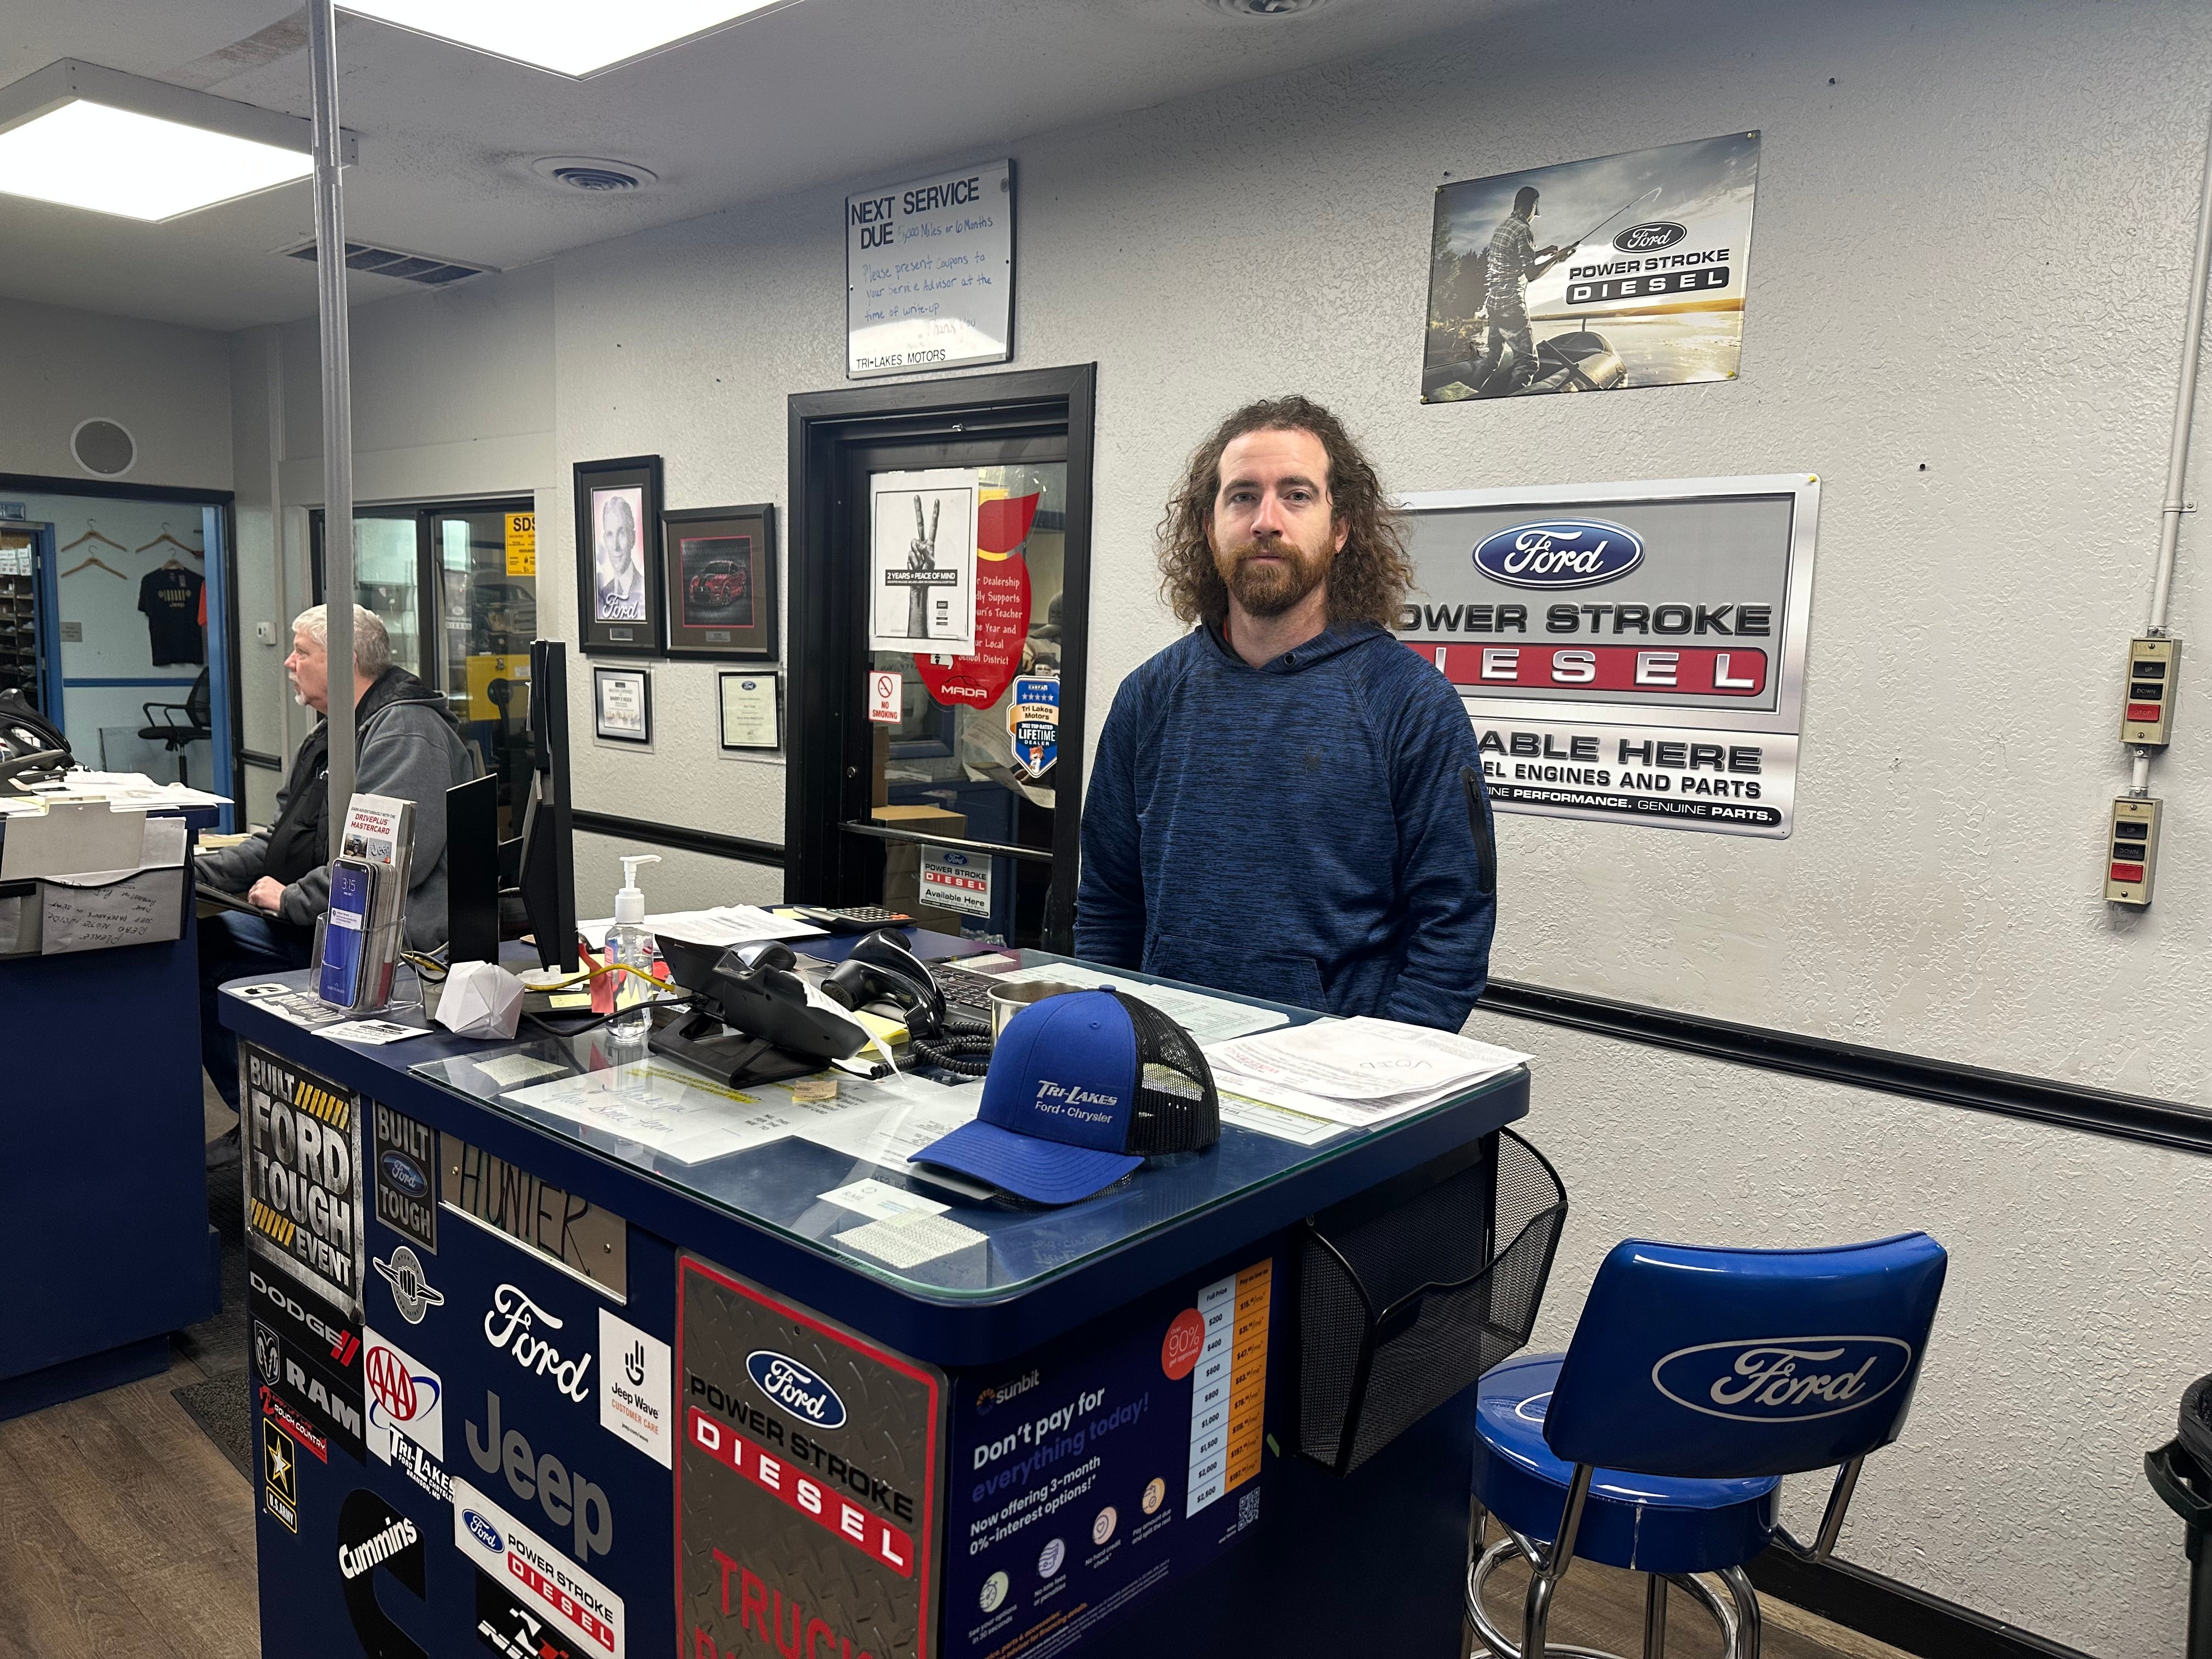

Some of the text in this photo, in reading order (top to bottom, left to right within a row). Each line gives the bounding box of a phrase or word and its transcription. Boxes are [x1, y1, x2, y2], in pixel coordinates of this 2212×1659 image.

[851, 177, 979, 225] NEXT SERVICE
[861, 222, 894, 249] DUE
[921, 223, 941, 238] Miles
[956, 221, 962, 233] 6
[964, 217, 993, 231] Months
[1627, 227, 1671, 249] Ford
[862, 263, 891, 283] Please
[896, 255, 932, 279] present
[975, 251, 985, 263] to
[1570, 249, 1729, 280] POWER STROKE
[923, 277, 956, 291] Advisor
[962, 277, 973, 285] at
[977, 273, 991, 285] the
[1573, 270, 1723, 301] DIESEL
[865, 303, 939, 322] time of write-up
[856, 349, 945, 369] TRI-LAKES MOTORS
[1504, 531, 1607, 574] Ford
[983, 577, 1020, 590] Dealership
[988, 591, 1020, 605] Supports
[603, 594, 638, 618] Ford
[995, 608, 1022, 619] Teacher
[1401, 602, 1772, 636] OWER STROKE
[985, 623, 1016, 634] Year and
[985, 639, 1003, 648] Local
[983, 654, 1008, 665] District
[1435, 647, 1754, 688] IESEL
[881, 701, 889, 709] NO
[941, 685, 987, 698] MADA
[873, 710, 898, 719] SMOKING
[1019, 729, 1055, 741] LIFETIME
[1618, 739, 1762, 774] HERE
[1515, 765, 1610, 786] ENGINES
[1620, 772, 1669, 790] AND
[1681, 777, 1760, 797] PARTS
[356, 814, 387, 825] DRIVEPLUS
[1514, 789, 1631, 808] PERFORMANCE.
[1638, 800, 1706, 815] GENUINE
[1712, 807, 1772, 821] PARTS.
[351, 821, 390, 834] MASTERCARD
[926, 864, 986, 880] POWER STROKE
[947, 854, 963, 864] Ford
[342, 878, 356, 891] 3:15
[926, 872, 984, 890] DIESEL
[926, 889, 984, 906] Available Here
[250, 1054, 295, 1104] BUILT
[1036, 1080, 1118, 1106] TRI-LAKES
[1035, 1101, 1113, 1124] Ford Chrysler
[252, 1089, 349, 1195] FORD
[378, 1107, 428, 1162] BUILT
[391, 1160, 416, 1188] Ford
[254, 1149, 350, 1255] TOUGH
[380, 1184, 431, 1239] TOUGH
[460, 1142, 590, 1277] HUNTER
[296, 1231, 351, 1287] EVENT
[250, 1271, 343, 1351] DODGE
[1209, 1313, 1222, 1326] $200
[484, 1284, 591, 1402] Ford
[1169, 1324, 1199, 1357] 90%
[1207, 1339, 1221, 1351] $400
[368, 1347, 415, 1420] AAA
[764, 1360, 826, 1419] Ford
[996, 1369, 1040, 1404] sunbit
[1710, 1348, 1877, 1406] Ford
[286, 1357, 361, 1440] RAM
[612, 1382, 658, 1419] Jeep Wave
[274, 1404, 325, 1450] ROUGH COUNTRY
[612, 1399, 658, 1435] CUSTOMER CARE
[974, 1388, 1105, 1470] Don't pay for
[1202, 1413, 1219, 1427] $1,000
[399, 1454, 413, 1470] FORD
[691, 1374, 913, 1522] POWER STROKE
[972, 1392, 1148, 1502] everything today!
[407, 1469, 440, 1501] BRANSON, MO
[465, 1389, 613, 1563] Jeep
[1199, 1462, 1217, 1478] $2,000
[696, 1416, 903, 1566] DIESEL
[970, 1456, 1101, 1537] Now offering 3-month
[470, 1516, 495, 1547] Ford
[969, 1505, 1042, 1555] 0%-interest
[339, 1517, 417, 1579] Cummins
[1085, 1540, 1121, 1566] No hard credit
[509, 1533, 613, 1624] POWER STROKE
[1034, 1574, 1066, 1597] No late fees
[1041, 1583, 1066, 1605] penalties
[512, 1557, 610, 1646] DIESEL
[713, 1547, 881, 1659] TRUC
[968, 1604, 1017, 1638] See your options
[973, 1616, 1012, 1644] in 30 seconds
